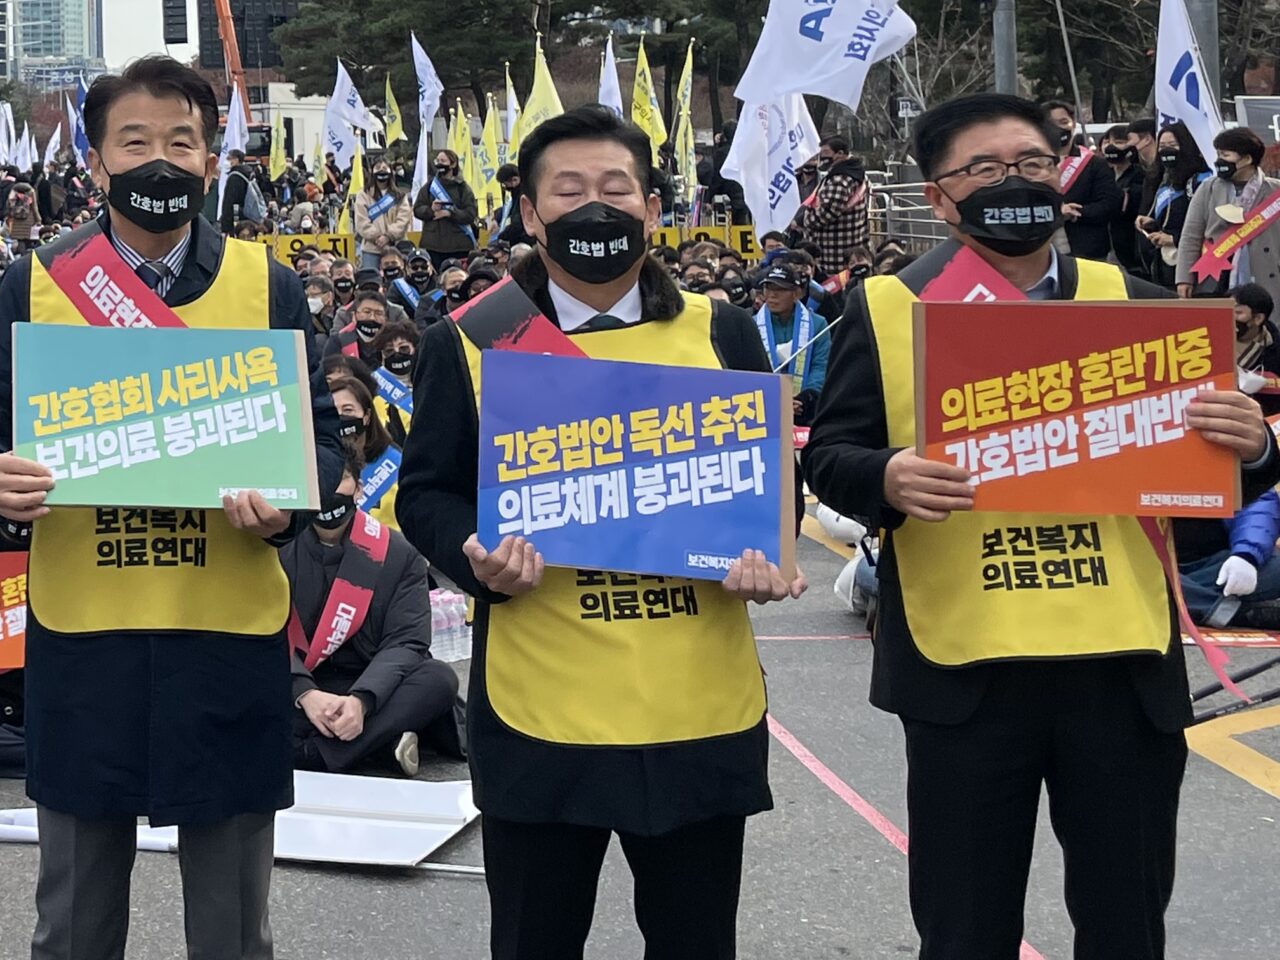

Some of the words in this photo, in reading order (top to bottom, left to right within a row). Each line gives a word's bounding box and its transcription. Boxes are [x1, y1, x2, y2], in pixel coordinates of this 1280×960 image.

[130, 192, 165, 214] 간호법
[168, 194, 188, 213] 반대
[983, 207, 1031, 224] 간호법
[569, 239, 605, 257] 간호법
[609, 235, 628, 255] 반대
[29, 371, 154, 437] 간호협회
[157, 346, 278, 407] 사리사욕
[941, 361, 1073, 432] 의료현장
[1078, 327, 1212, 404] 혼란가중
[35, 420, 160, 480] 보건의료
[164, 391, 287, 457] 붕괴된다
[493, 415, 624, 482] 간호법안
[629, 402, 695, 457] 독선
[701, 390, 767, 446] 추진
[945, 415, 1080, 486] 간호법안
[498, 469, 629, 535] 의료체계
[633, 446, 765, 516] 붕괴된다
[1140, 493, 1224, 507] 보건복지의료연대
[96, 537, 207, 568] 의료연대
[982, 521, 1102, 559] 보건복지
[982, 556, 1109, 591] 의료연대
[580, 585, 698, 622] 의료연대
